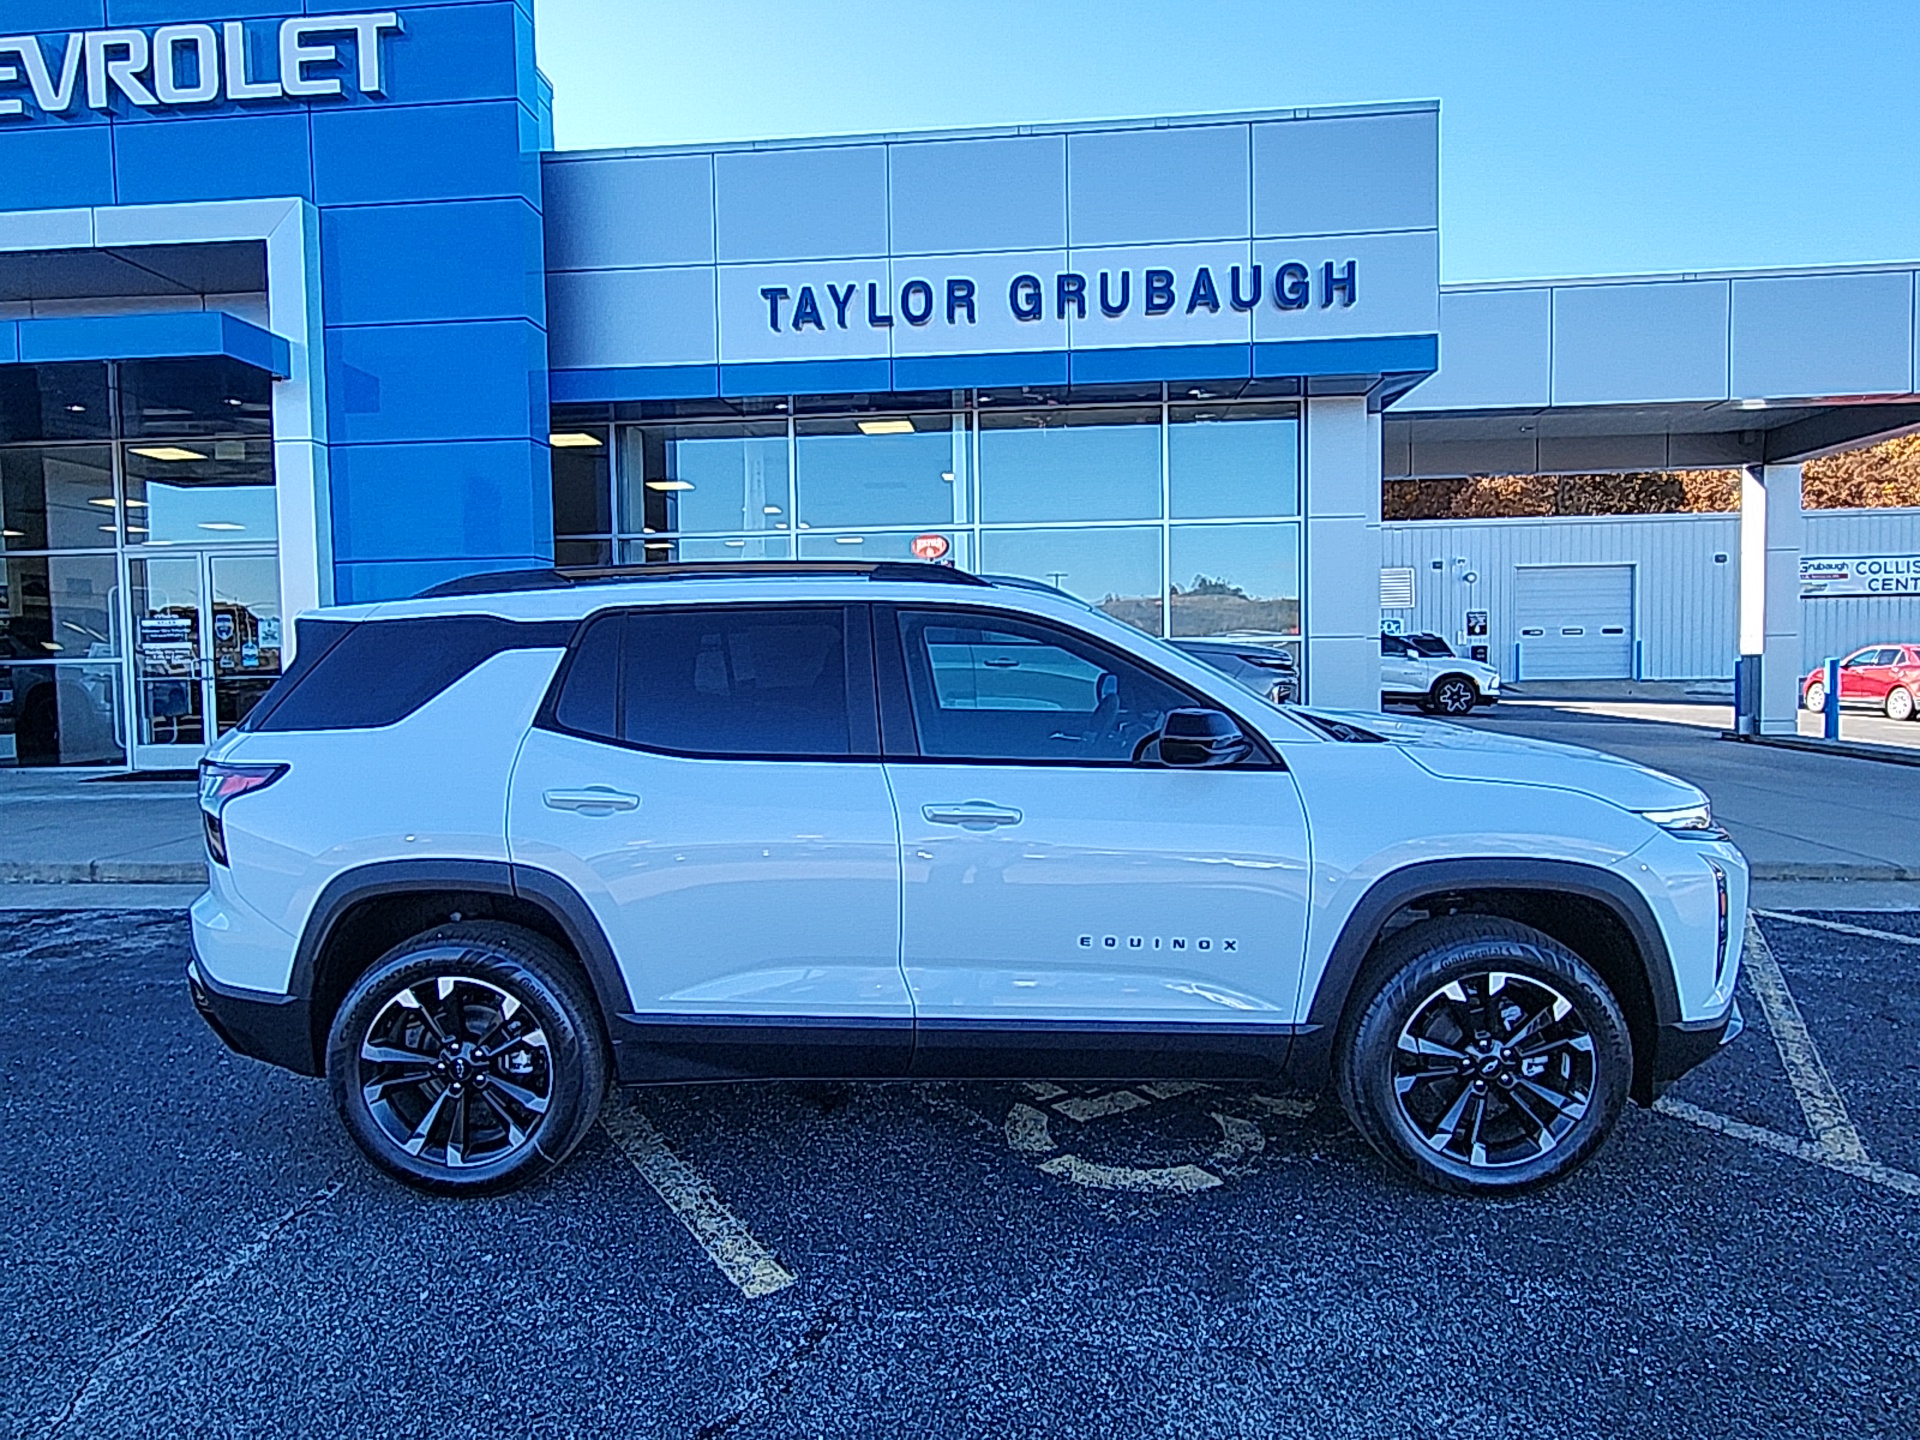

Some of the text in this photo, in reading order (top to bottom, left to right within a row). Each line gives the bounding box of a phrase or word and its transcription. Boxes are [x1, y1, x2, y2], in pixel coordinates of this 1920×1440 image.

[760, 260, 1357, 332] TAYLOR GRUBAUGH
[1856, 560, 1920, 575] COLLIS
[1868, 577, 1920, 591] CENT
[1080, 936, 1237, 950] EQUINOX
